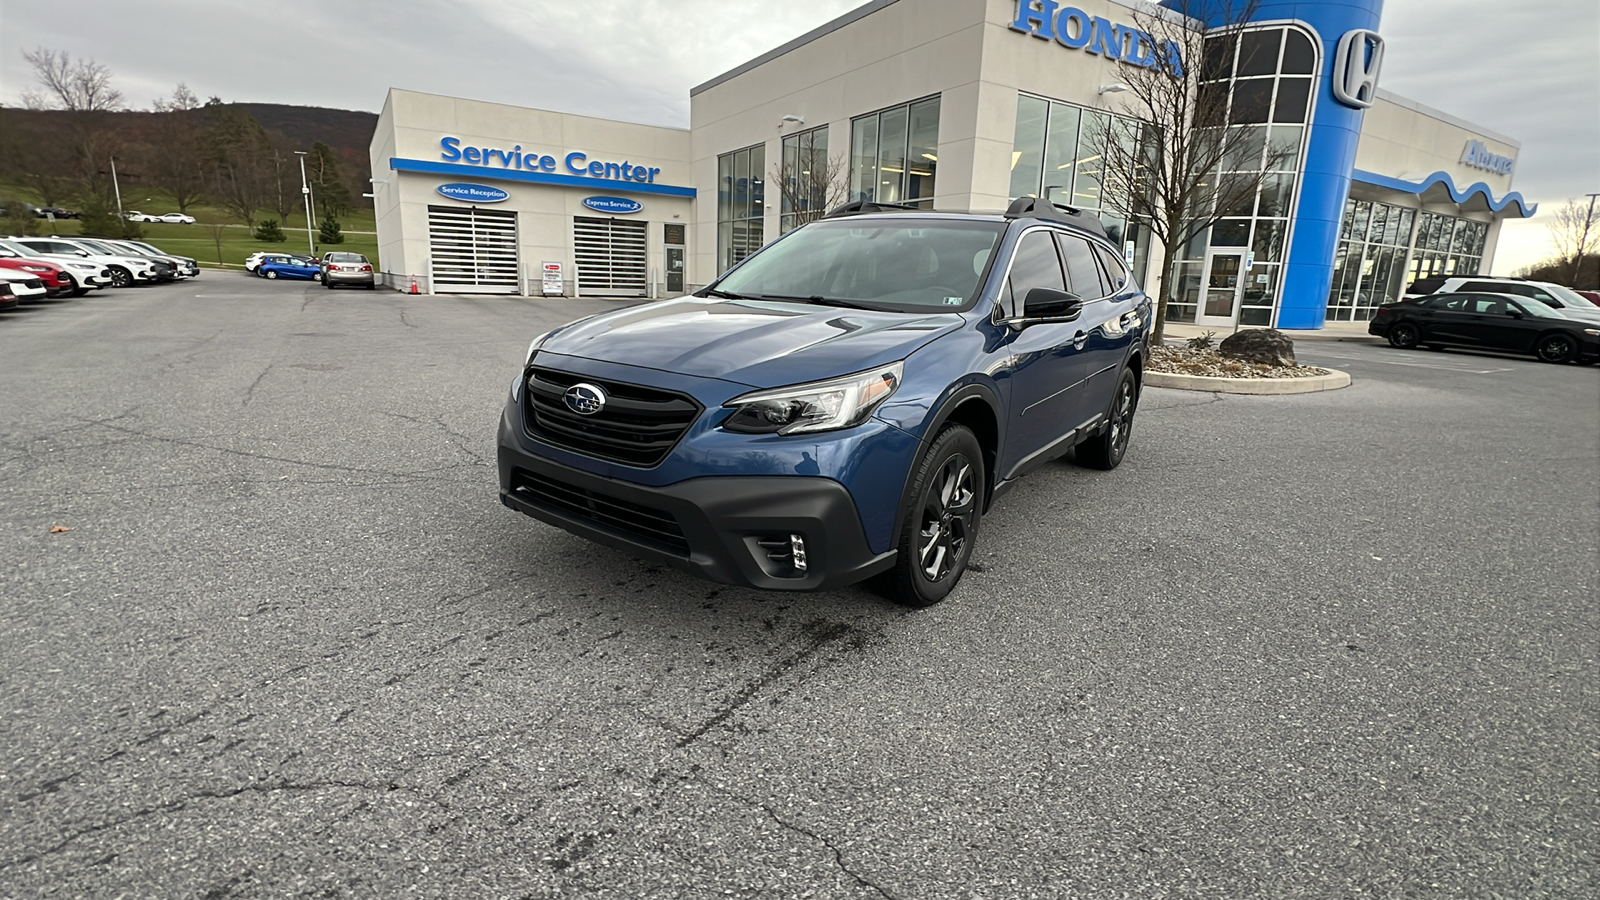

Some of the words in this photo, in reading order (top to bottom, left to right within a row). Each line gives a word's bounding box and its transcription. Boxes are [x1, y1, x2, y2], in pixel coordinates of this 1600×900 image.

[1009, 0, 1184, 78] HONDA
[440, 136, 557, 172] Service
[565, 152, 661, 183] Center
[441, 186, 469, 195] Service
[470, 188, 506, 198] Reception
[586, 198, 609, 207] Express
[610, 200, 631, 209] Service
